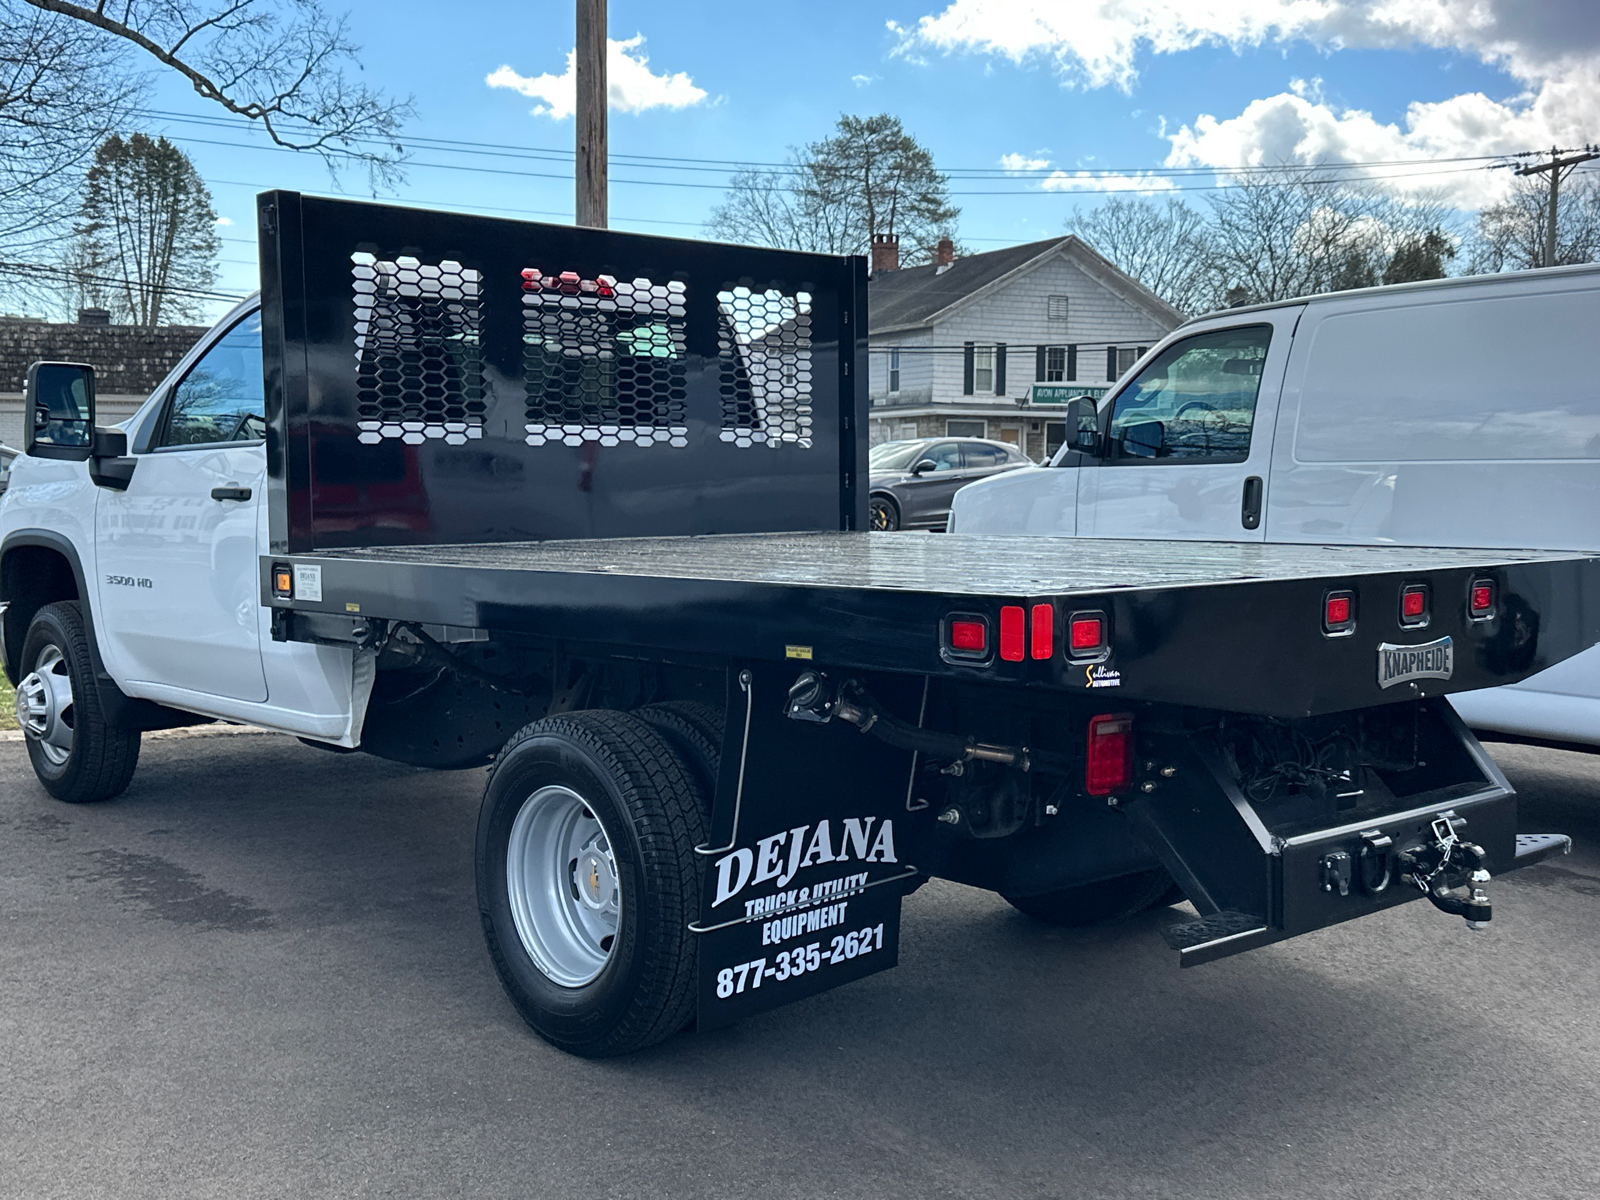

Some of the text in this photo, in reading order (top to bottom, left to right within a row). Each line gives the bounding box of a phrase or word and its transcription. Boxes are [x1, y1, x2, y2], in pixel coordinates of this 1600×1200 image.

[1036, 388, 1053, 398] AVON
[1054, 388, 1086, 399] APPLIANCE
[105, 574, 153, 589] 3500 HD
[1085, 664, 1121, 688] Sullivan
[1383, 643, 1450, 681] KNAPHEIDE
[711, 816, 898, 908] DEJANA
[744, 888, 799, 924] TRUCK
[812, 871, 869, 905] UTILITY
[762, 901, 848, 946] EQUIPMENT
[716, 922, 884, 999] 877-335-2621
